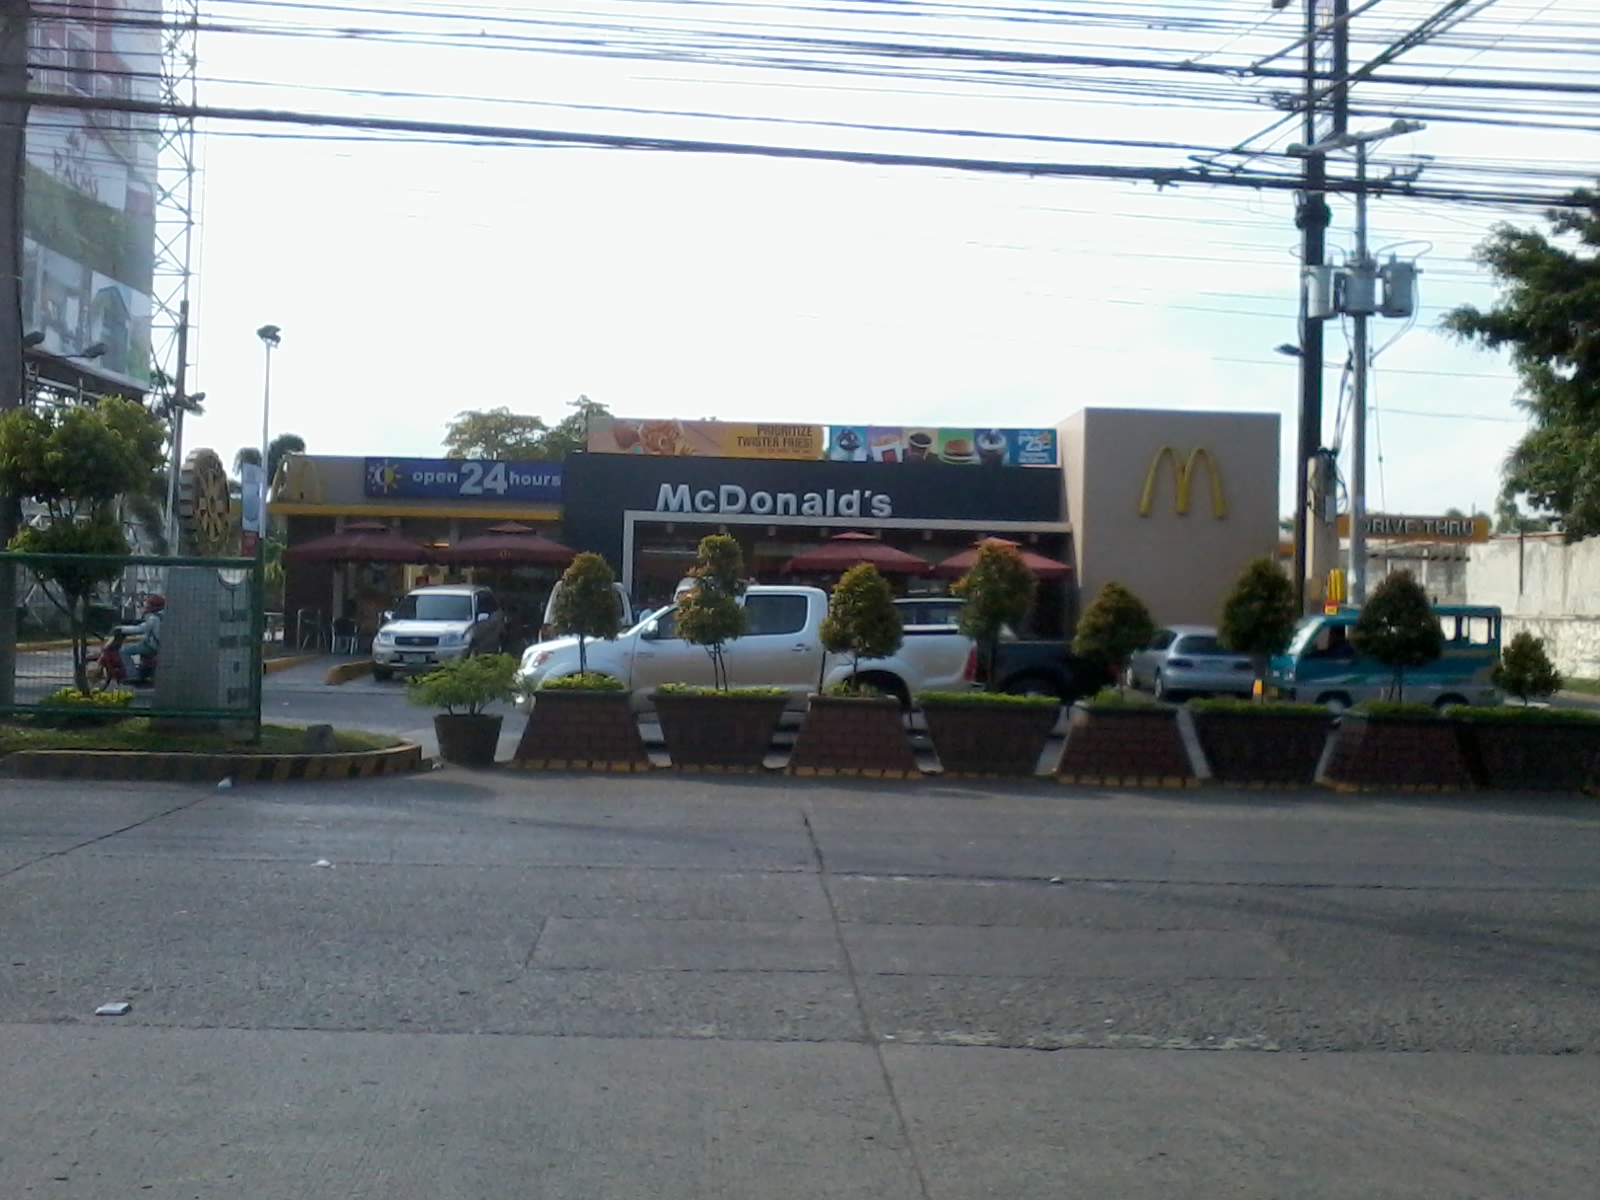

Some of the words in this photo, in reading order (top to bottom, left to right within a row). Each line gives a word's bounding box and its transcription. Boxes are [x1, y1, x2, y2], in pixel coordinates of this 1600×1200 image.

[757, 425, 813, 437] PRIORITIZE
[736, 436, 780, 448] TWISTER
[782, 437, 813, 448] FRIES!
[412, 470, 459, 486] open
[459, 461, 508, 496] 24
[509, 471, 561, 487] hours
[656, 483, 893, 517] McDonald's
[1422, 519, 1476, 537] THRU
